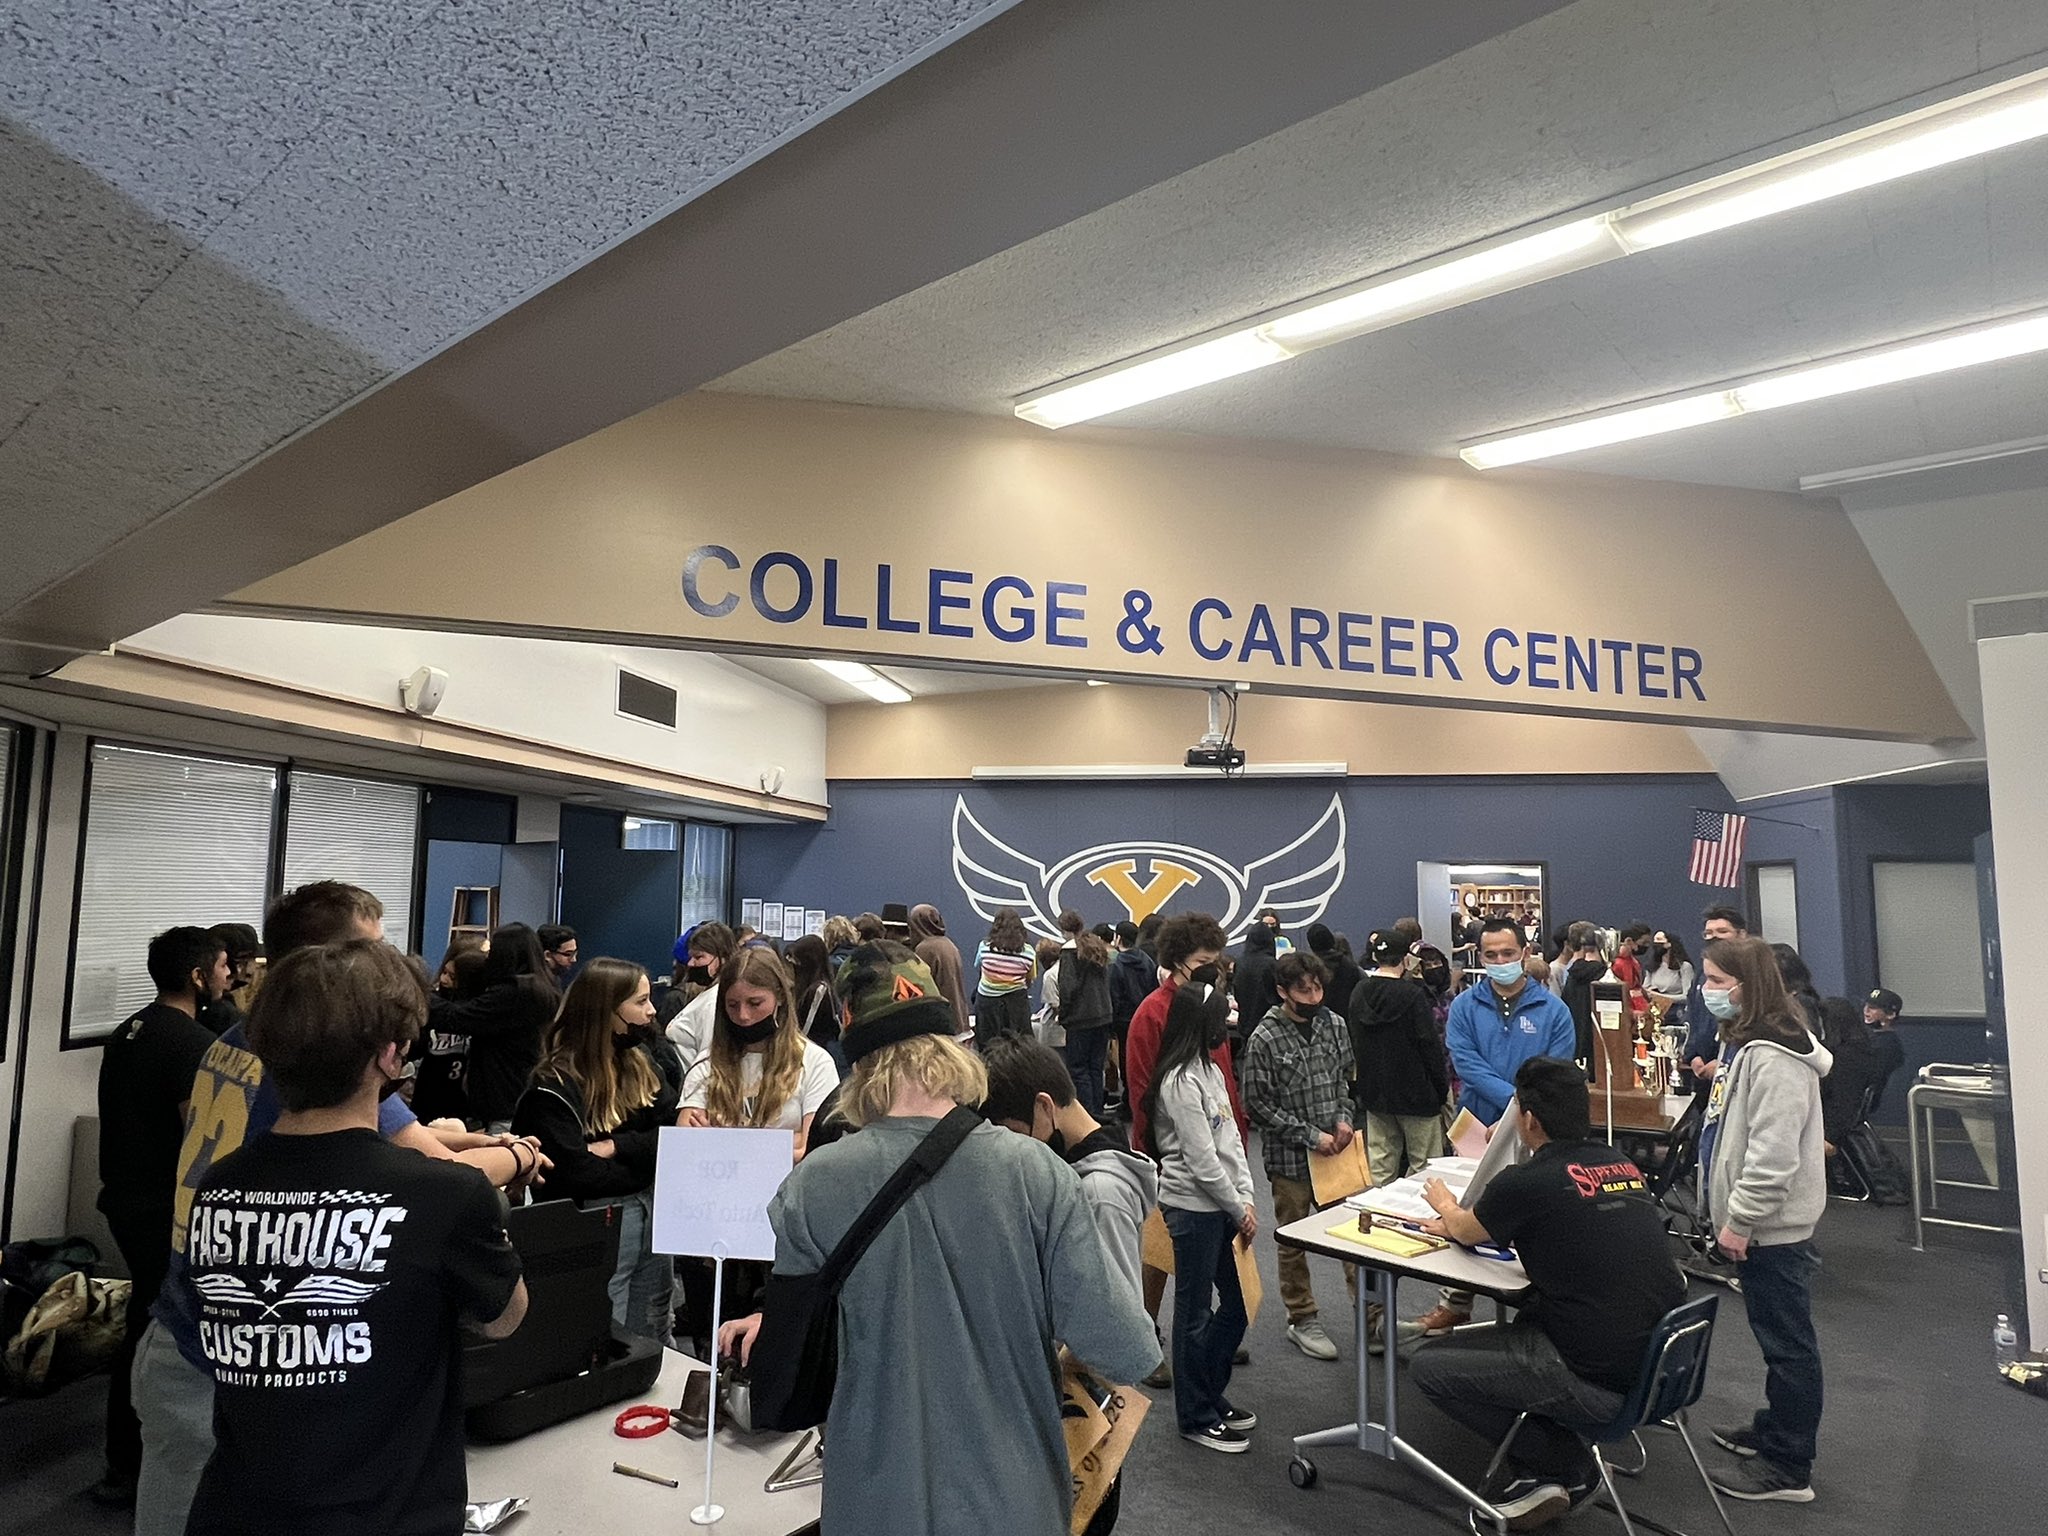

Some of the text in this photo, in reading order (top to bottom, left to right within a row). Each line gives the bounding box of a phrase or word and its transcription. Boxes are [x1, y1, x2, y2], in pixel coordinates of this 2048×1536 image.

[681, 544, 1706, 701] COLLEGE & CAREER CENTER
[1085, 858, 1203, 928] Y
[449, 1061, 462, 1079] 3
[244, 1191, 317, 1205] WORLDWIDE
[190, 1206, 408, 1272] FASTHOUSE
[200, 1320, 372, 1369] CUSTOMS
[215, 1368, 347, 1388] QUALITY PRODUCTS
